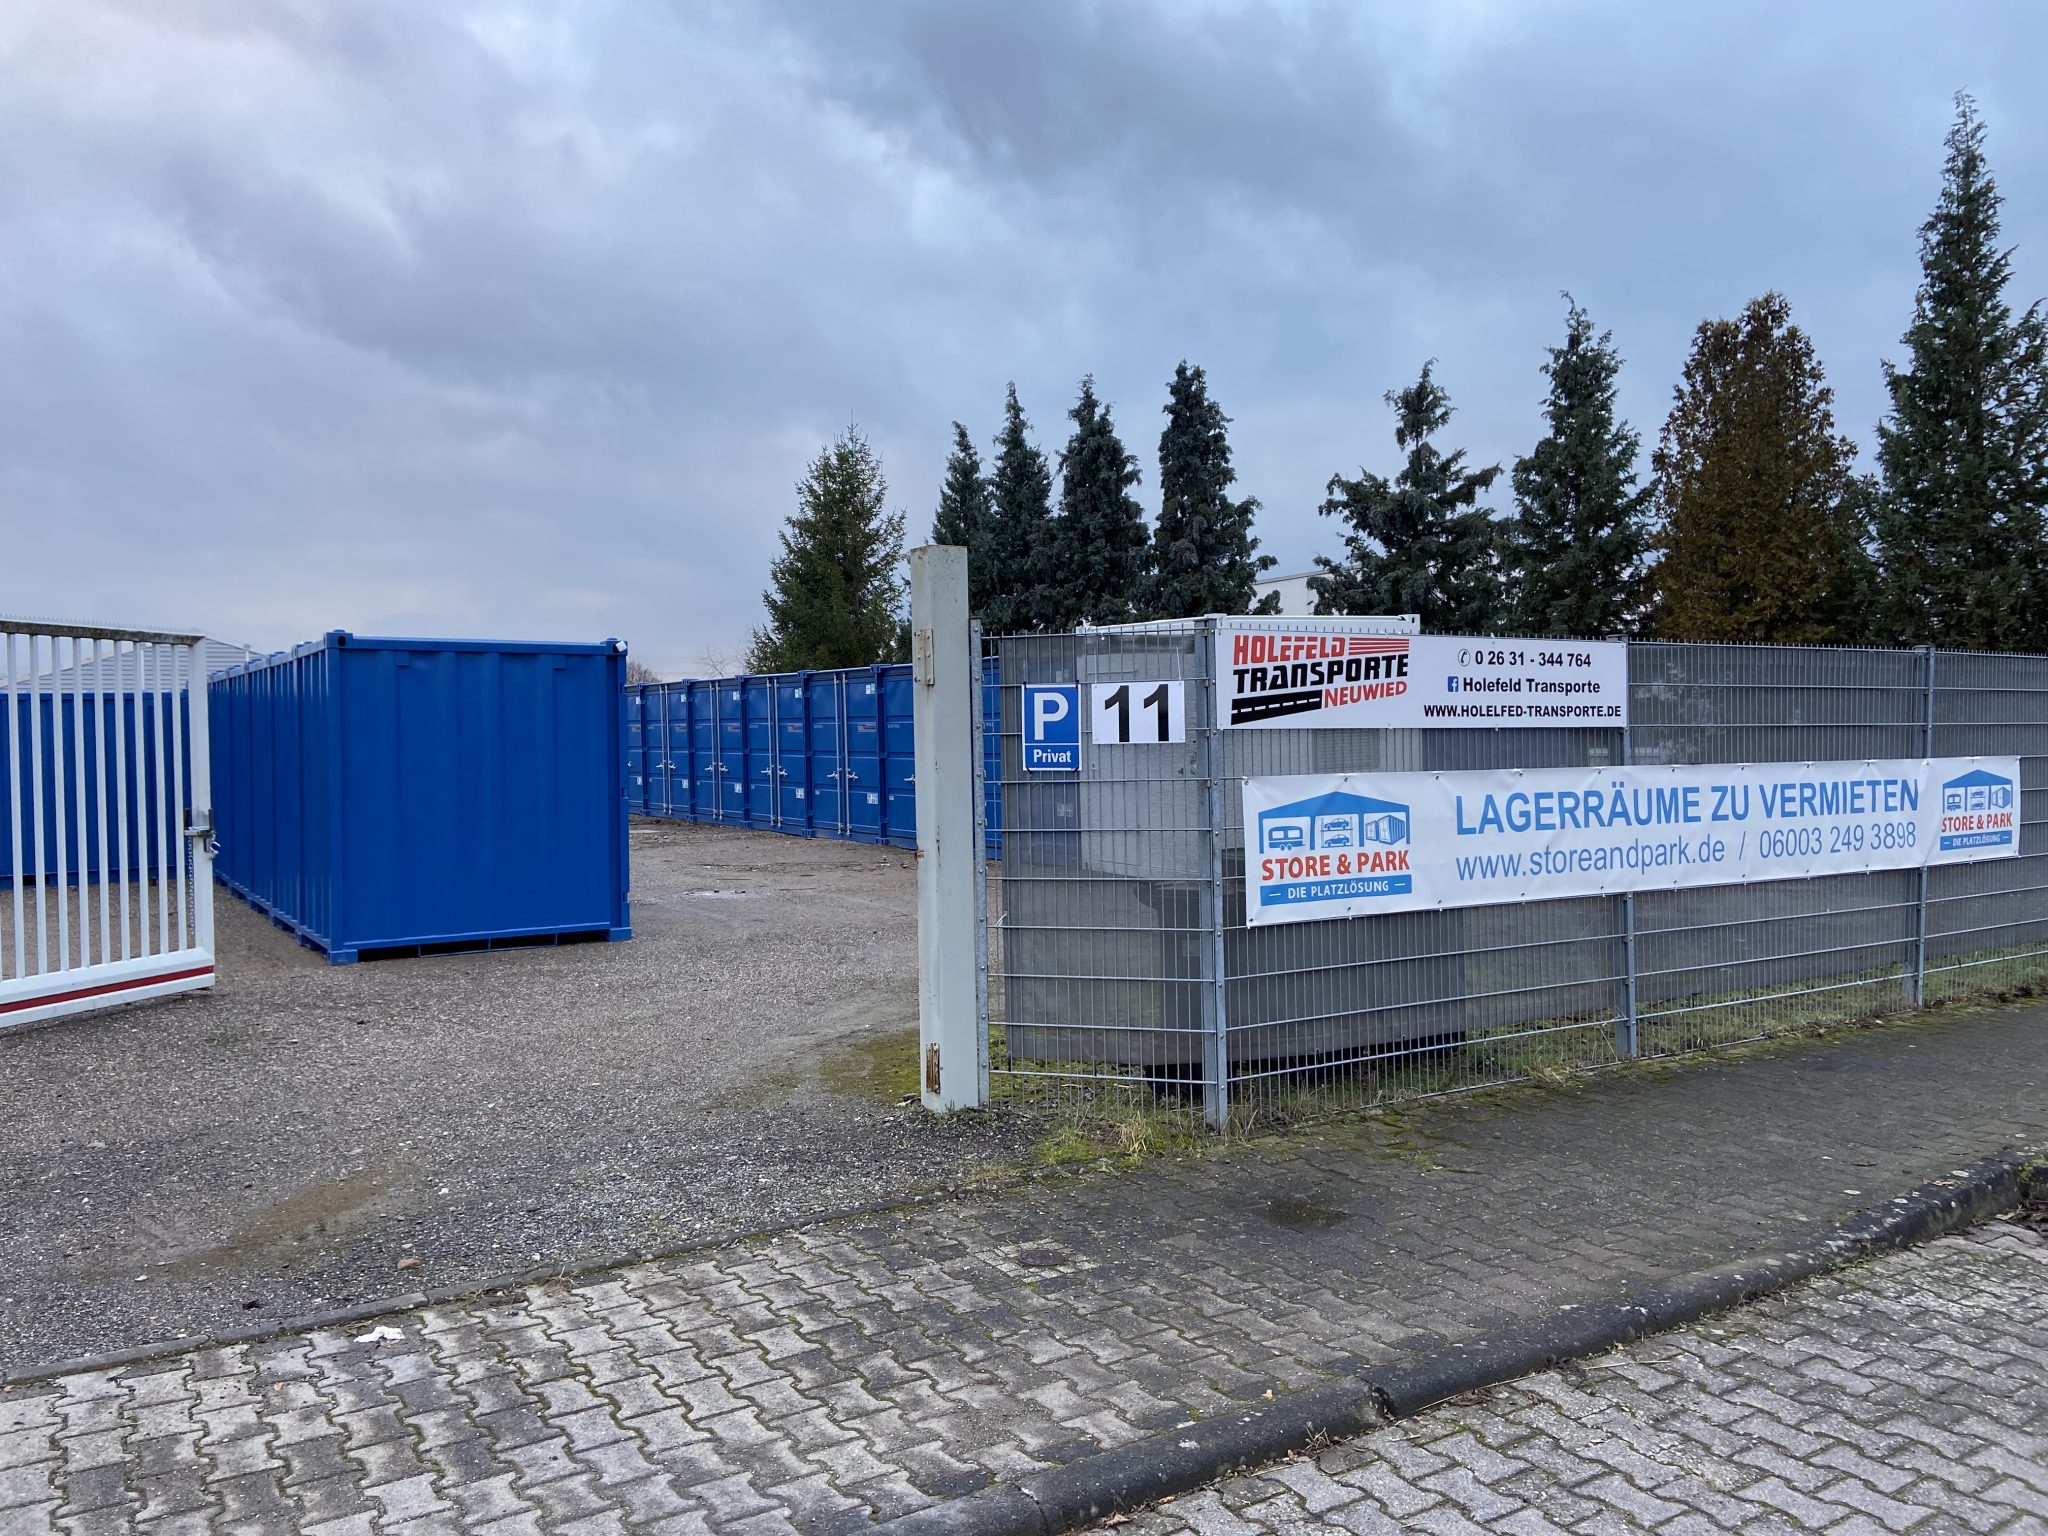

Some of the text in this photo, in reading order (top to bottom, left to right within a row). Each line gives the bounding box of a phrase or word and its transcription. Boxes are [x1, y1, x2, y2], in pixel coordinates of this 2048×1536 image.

[1233, 635, 1346, 665] HOLEFELD
[1475, 651, 1483, 665] 0
[1488, 651, 1504, 666] 26
[1509, 651, 1525, 666] 31
[1538, 652, 1563, 667] 344
[1567, 653, 1592, 667] 764
[1233, 654, 1409, 694] TRANSPORTE
[1463, 677, 1521, 692] Holefeld
[1526, 678, 1600, 696] Transporte
[1324, 680, 1408, 708] NEUWIED
[1034, 692, 1069, 741] P
[1104, 684, 1170, 742] 11
[1424, 704, 1621, 717] WWW.HOLELFED-TRANSPORTE.DE
[1033, 748, 1072, 763] Privat
[1455, 779, 1918, 835] LAGERRÄUME ZU VERMIETEN
[1941, 812, 2012, 832] STORE & PARK
[1456, 821, 1916, 881] www.storeandpark.de / 06003 249 3898
[1953, 834, 2000, 846] DIE PLATZLÖSUNG
[1261, 850, 1410, 881] STORE & PARK
[1288, 880, 1389, 899] DIE PLATZLÖSUNG
